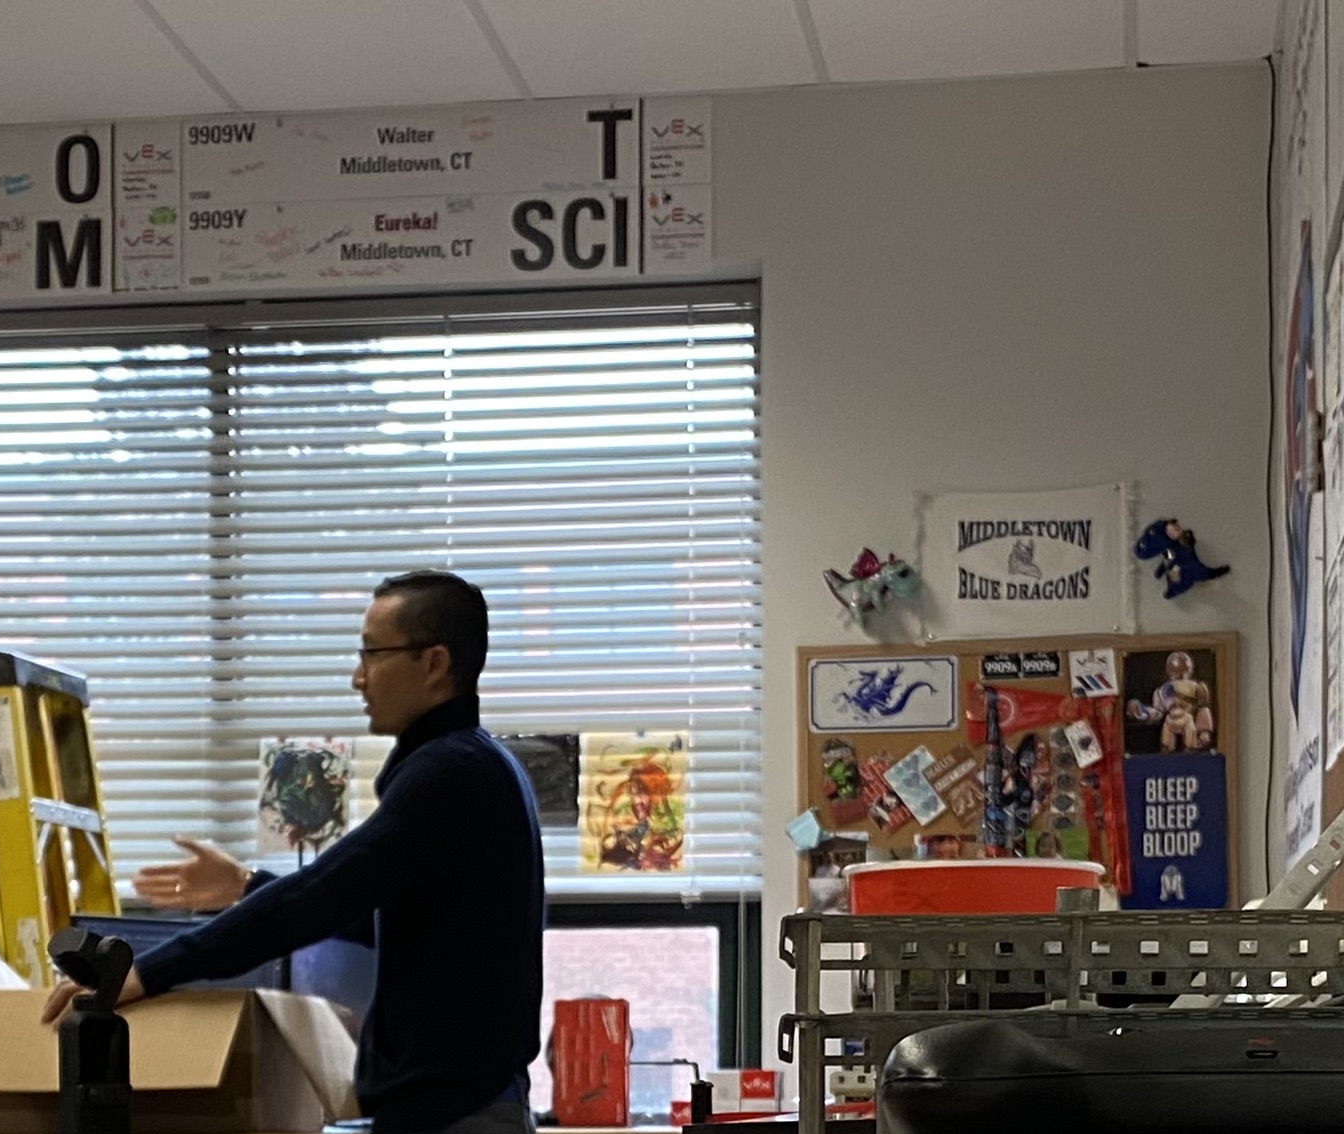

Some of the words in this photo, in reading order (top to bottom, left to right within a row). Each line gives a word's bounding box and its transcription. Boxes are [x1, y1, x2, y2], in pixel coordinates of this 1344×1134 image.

[189, 123, 256, 145] 9909W
[377, 127, 434, 145] Walter
[651, 119, 703, 137] VEX
[123, 144, 173, 162] VEX
[587, 109, 633, 180] T
[55, 134, 101, 204] O
[340, 156, 445, 174] Middletown,
[450, 152, 473, 170] CT
[189, 209, 247, 230] 9909Y
[375, 212, 438, 232] Eureka!
[510, 196, 628, 272] SCI
[36, 218, 102, 289] M
[340, 242, 445, 261] Middletown,
[451, 239, 474, 257] CT
[958, 519, 1092, 553] MIDDLETOWN
[958, 566, 1001, 600] BLUE
[1006, 565, 1090, 600] DRAGONS
[1145, 776, 1199, 803] BLEEP
[1145, 804, 1199, 830] BLEEP
[1142, 831, 1202, 858] BLOOP
